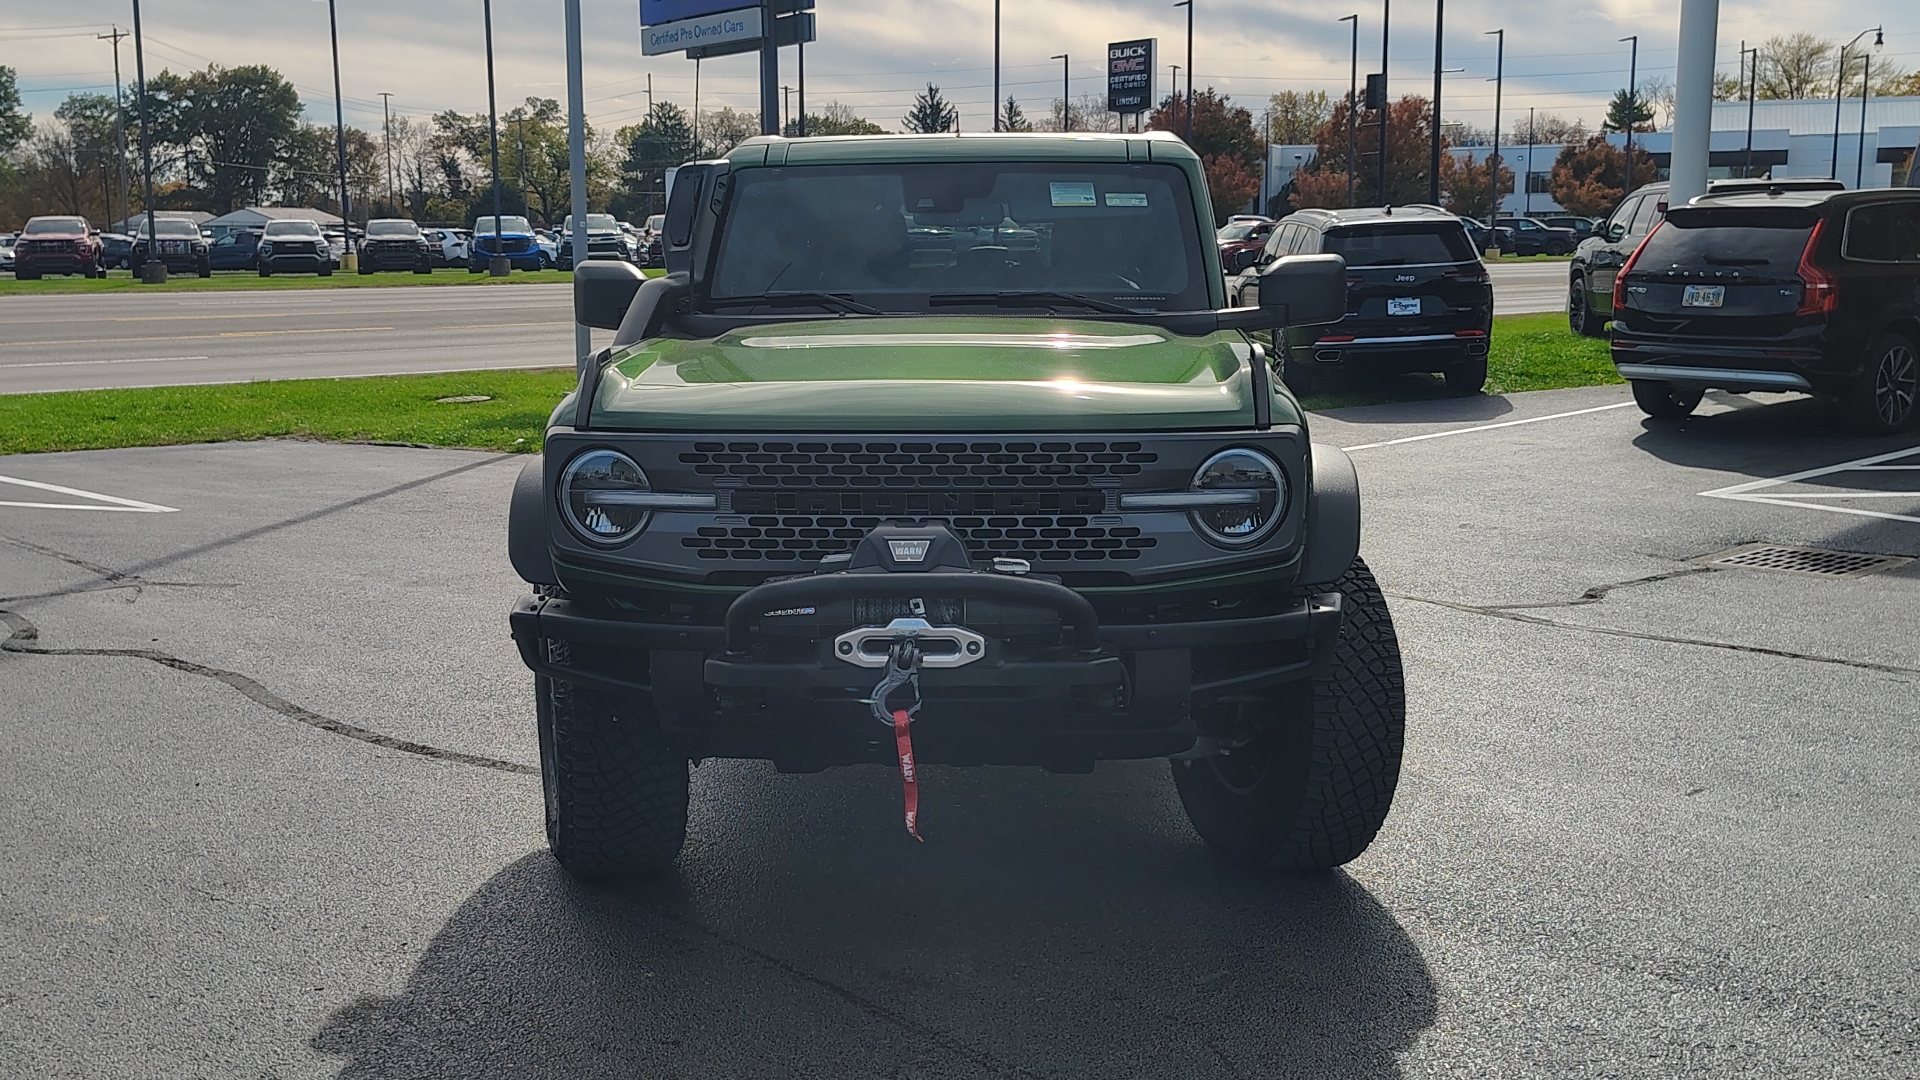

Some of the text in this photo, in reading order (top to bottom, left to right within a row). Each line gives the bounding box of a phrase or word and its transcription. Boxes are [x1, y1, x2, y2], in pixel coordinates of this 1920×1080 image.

[650, 19, 744, 46] Certified Pre Owned Cars
[1110, 46, 1146, 58] BUICK
[1112, 58, 1144, 73] GMC
[1110, 74, 1147, 83] CERTIFIED
[1395, 274, 1415, 282] Jeep
[895, 547, 922, 555] WARN
[902, 753, 914, 782] WARN
